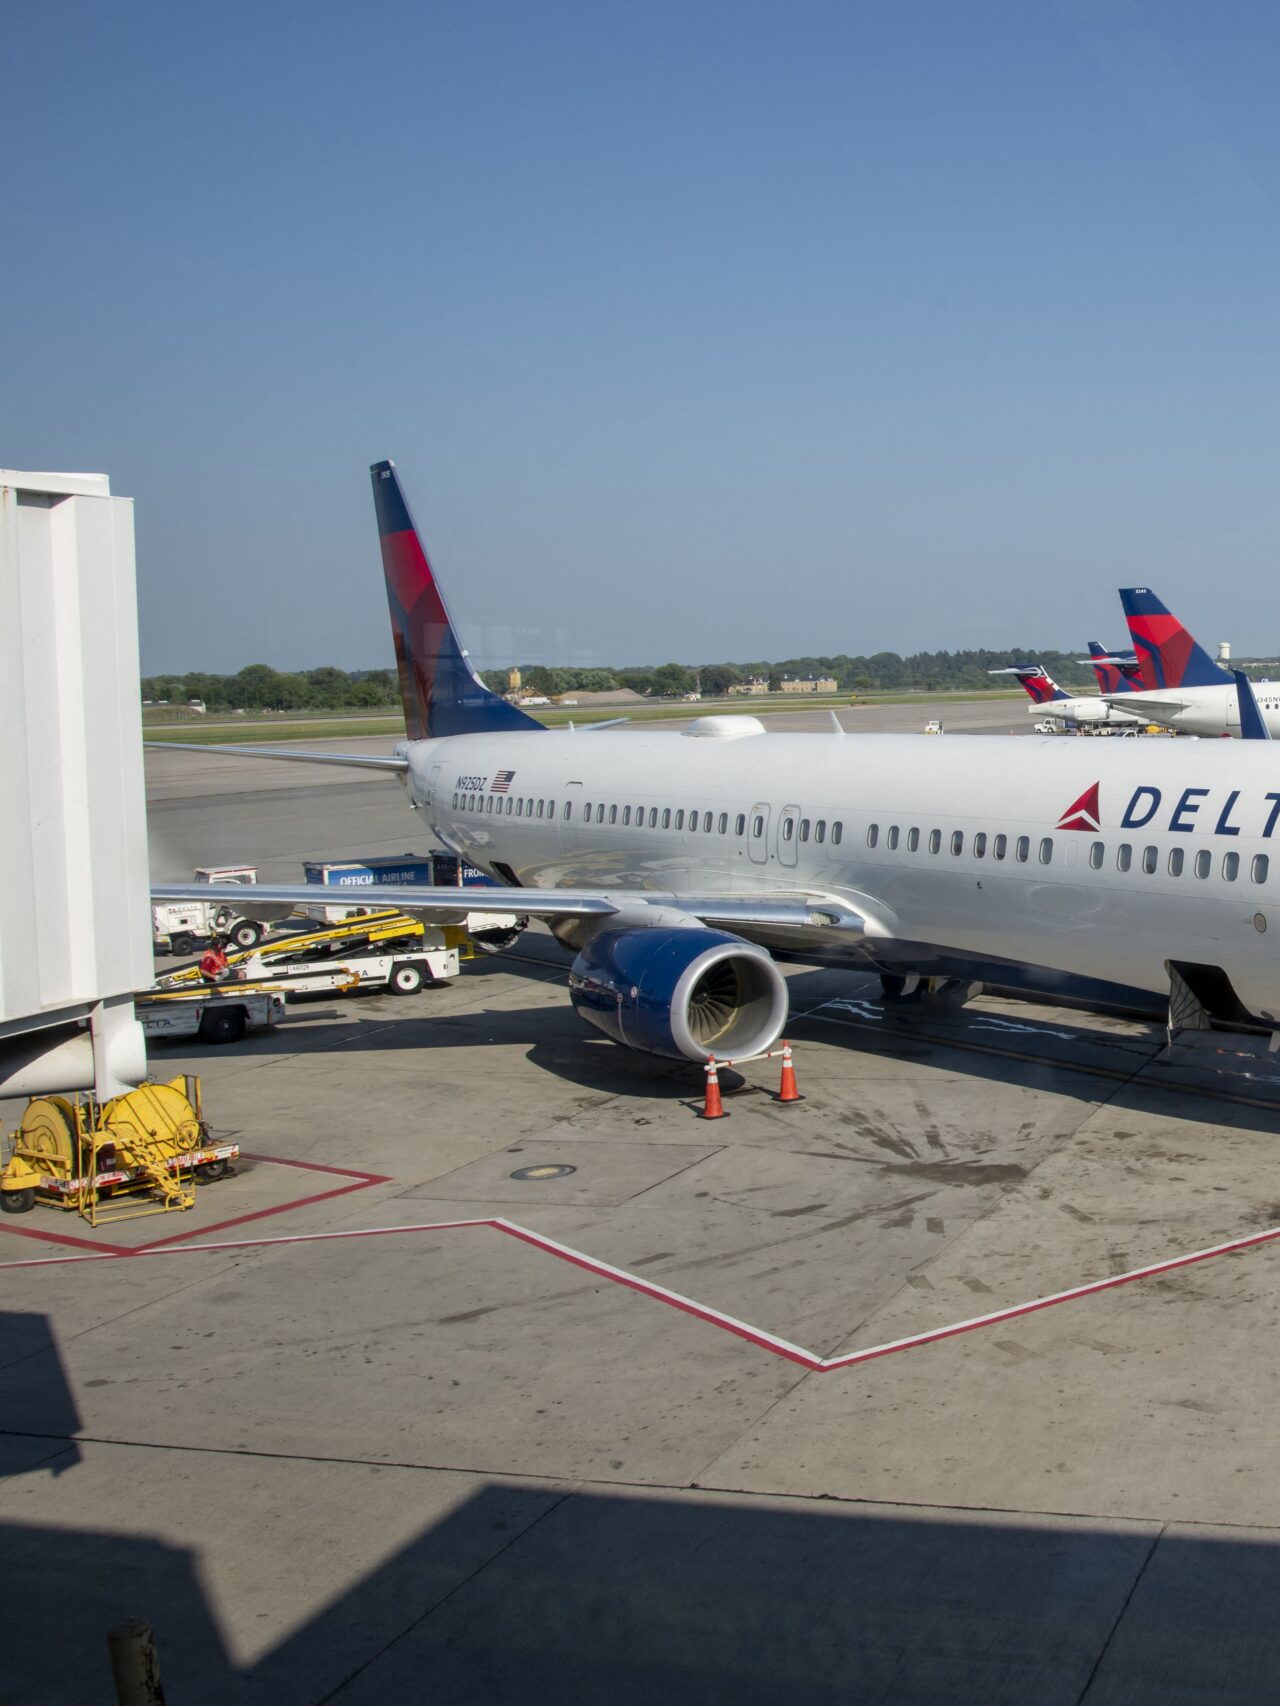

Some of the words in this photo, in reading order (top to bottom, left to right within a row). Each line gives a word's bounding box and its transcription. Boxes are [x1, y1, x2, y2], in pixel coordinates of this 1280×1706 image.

[456, 776, 488, 791] N925DZ
[340, 875, 380, 886] OFFICIAL
[382, 871, 416, 883] AIRLINE
